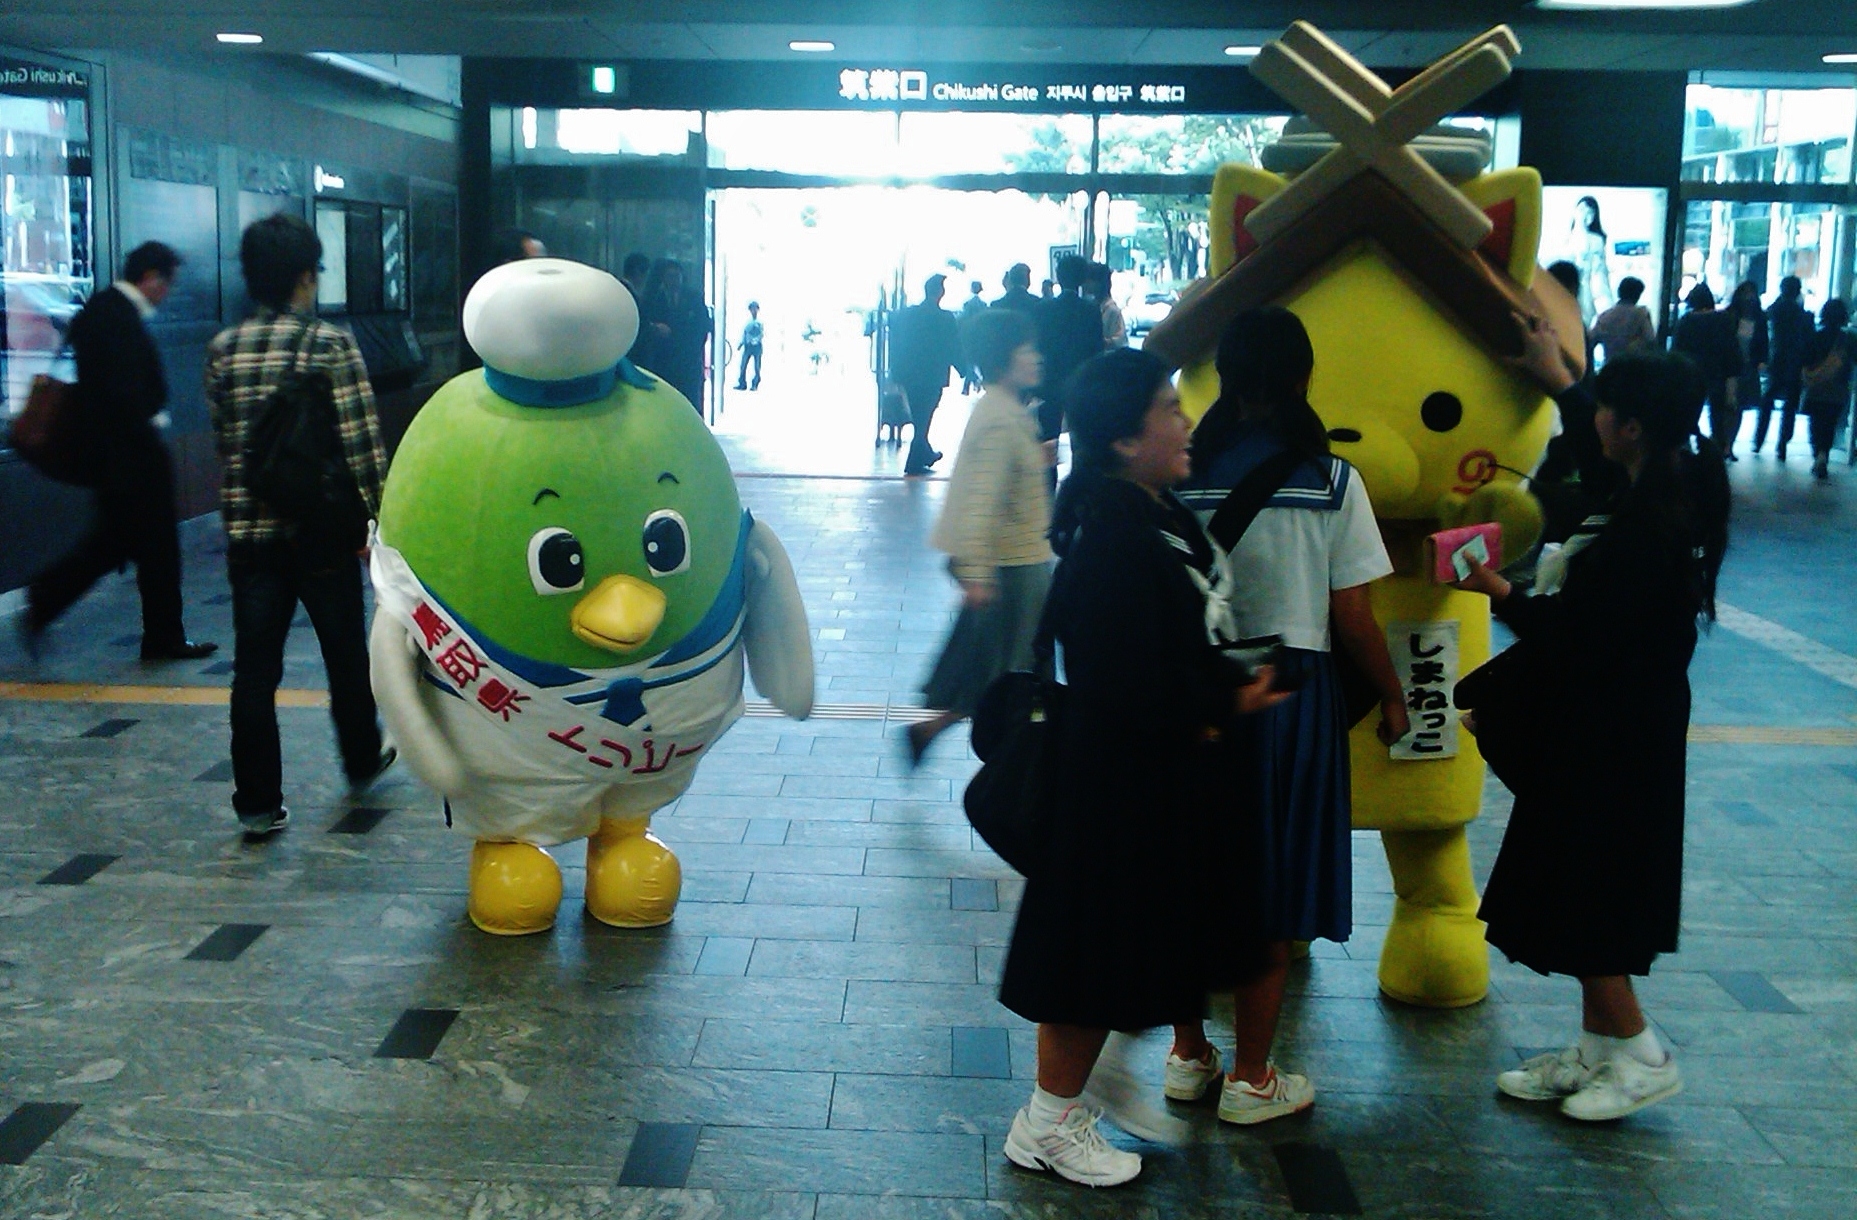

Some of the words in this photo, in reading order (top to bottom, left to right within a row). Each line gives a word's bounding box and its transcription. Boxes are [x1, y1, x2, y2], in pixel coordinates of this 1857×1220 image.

[932, 82, 998, 101] Chikushi
[1001, 83, 1039, 102] Gate
[1407, 633, 1448, 753] しまねっこ
